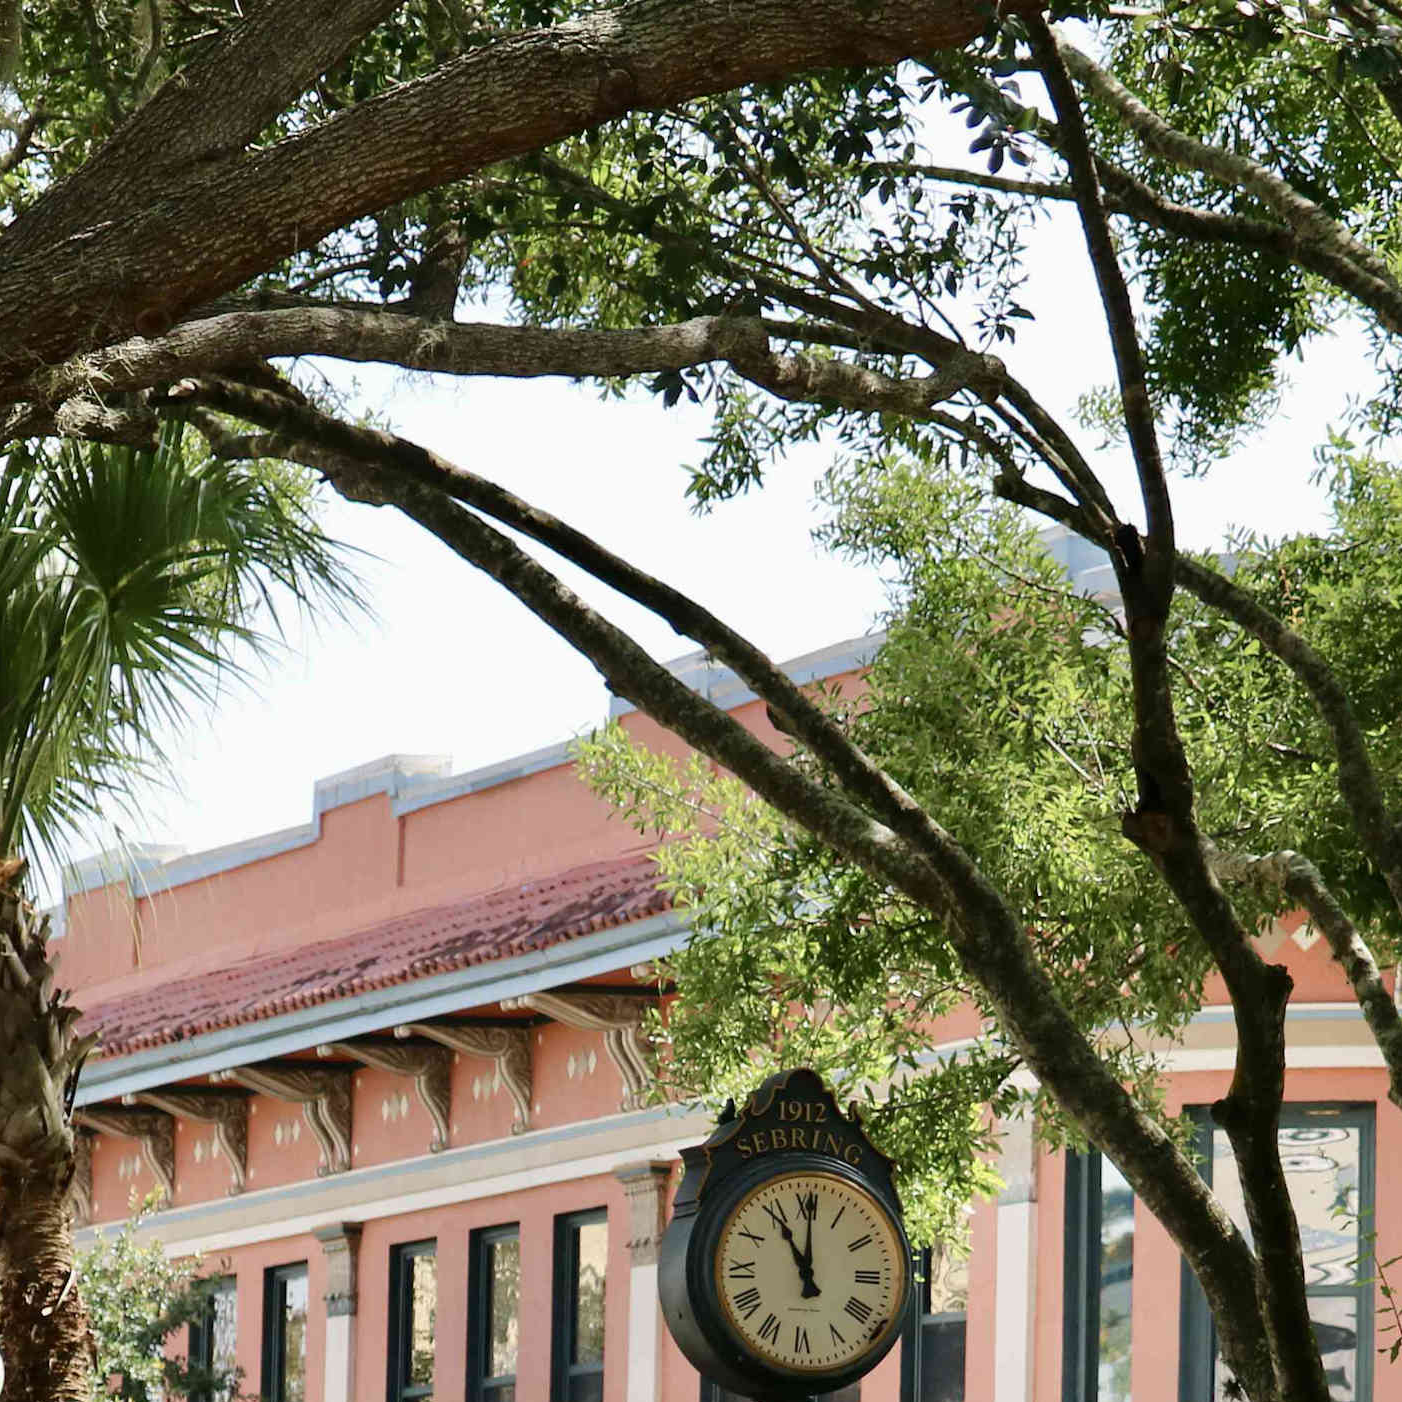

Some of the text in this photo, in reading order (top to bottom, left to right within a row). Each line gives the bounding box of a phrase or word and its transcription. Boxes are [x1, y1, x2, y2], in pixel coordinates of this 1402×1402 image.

[779, 1100, 826, 1123] 1912
[736, 1127, 863, 1165] SEBRING
[796, 1193, 818, 1220] XI
[738, 1224, 765, 1248] X
[847, 1234, 873, 1253] II
[729, 1259, 756, 1279] IX
[855, 1270, 881, 1285] III
[733, 1287, 762, 1320] VIII
[844, 1296, 873, 1325] IIII
[757, 1313, 782, 1345] VII
[794, 1325, 810, 1354] VI
[829, 1323, 846, 1347] V
